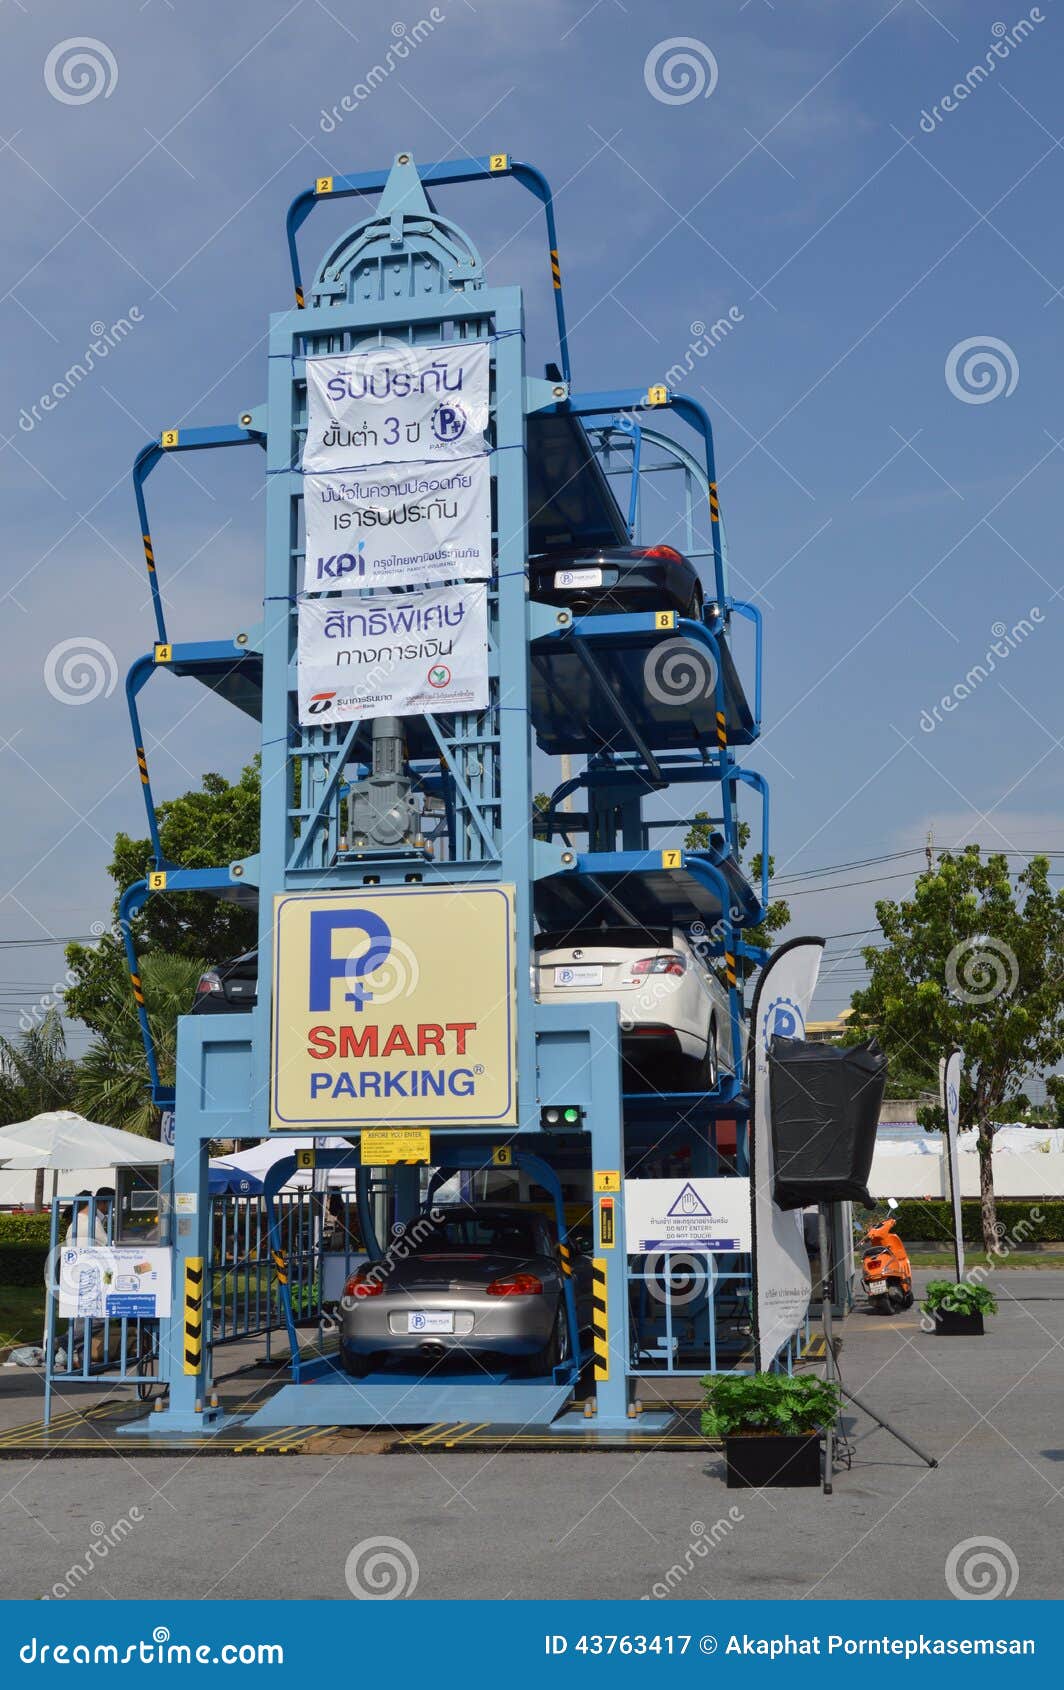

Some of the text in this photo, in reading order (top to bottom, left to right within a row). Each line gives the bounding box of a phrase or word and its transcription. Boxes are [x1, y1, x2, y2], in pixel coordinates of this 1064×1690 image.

[494, 157, 503, 168] 2
[320, 179, 329, 191] 2
[326, 362, 463, 401] รับประกัน
[654, 390, 660, 401] 1
[322, 416, 421, 447] ขั้นต่ำ 3 ปี
[166, 434, 174, 444] 3
[334, 498, 458, 530] เรารับประกัน
[324, 602, 465, 639] สิทธิพิเศษ
[660, 614, 669, 626] 8
[159, 647, 168, 658] 4
[336, 638, 453, 666] ทางการเงิน
[667, 853, 676, 865] 7
[154, 875, 162, 887] 5
[307, 1022, 477, 1060] SMART
[302, 1152, 311, 1165] 6
[497, 1150, 507, 1161] 6
